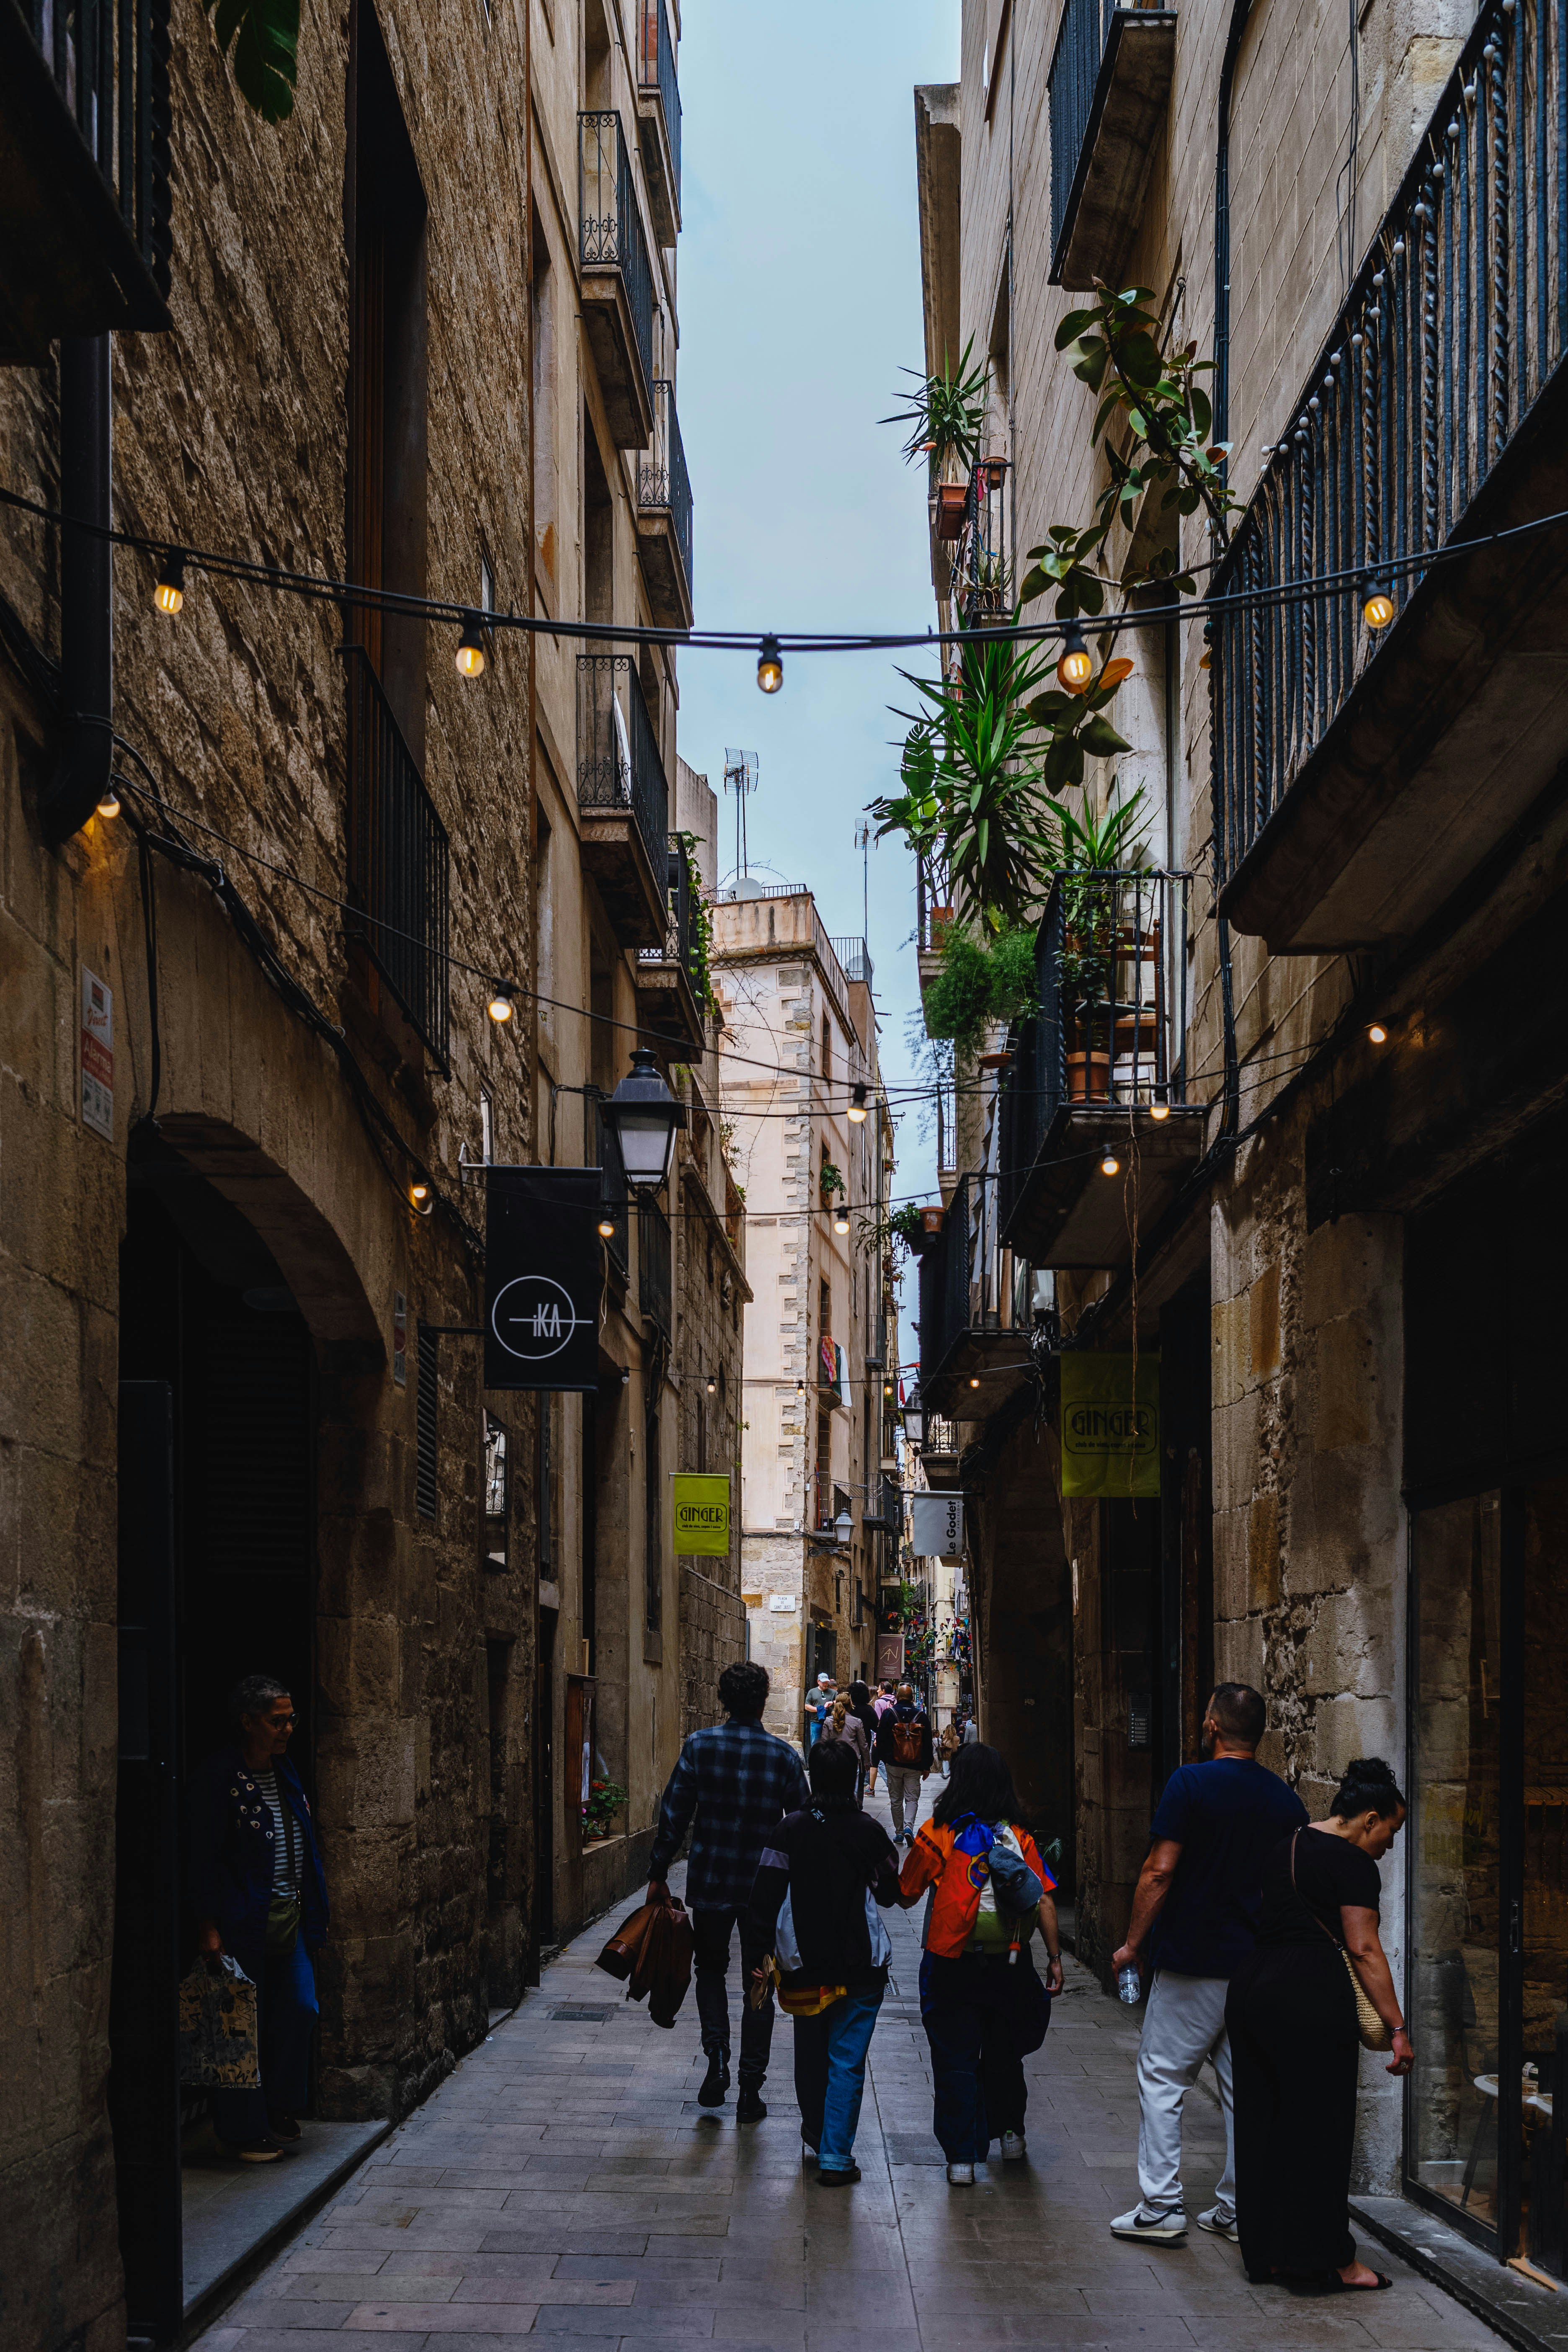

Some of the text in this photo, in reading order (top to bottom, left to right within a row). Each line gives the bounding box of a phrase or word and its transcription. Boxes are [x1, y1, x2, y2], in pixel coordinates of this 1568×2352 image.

[1071, 1410, 1150, 1436] GINGER
[680, 1507, 723, 1522] GINGER
[946, 1501, 957, 1555] Le Godet
